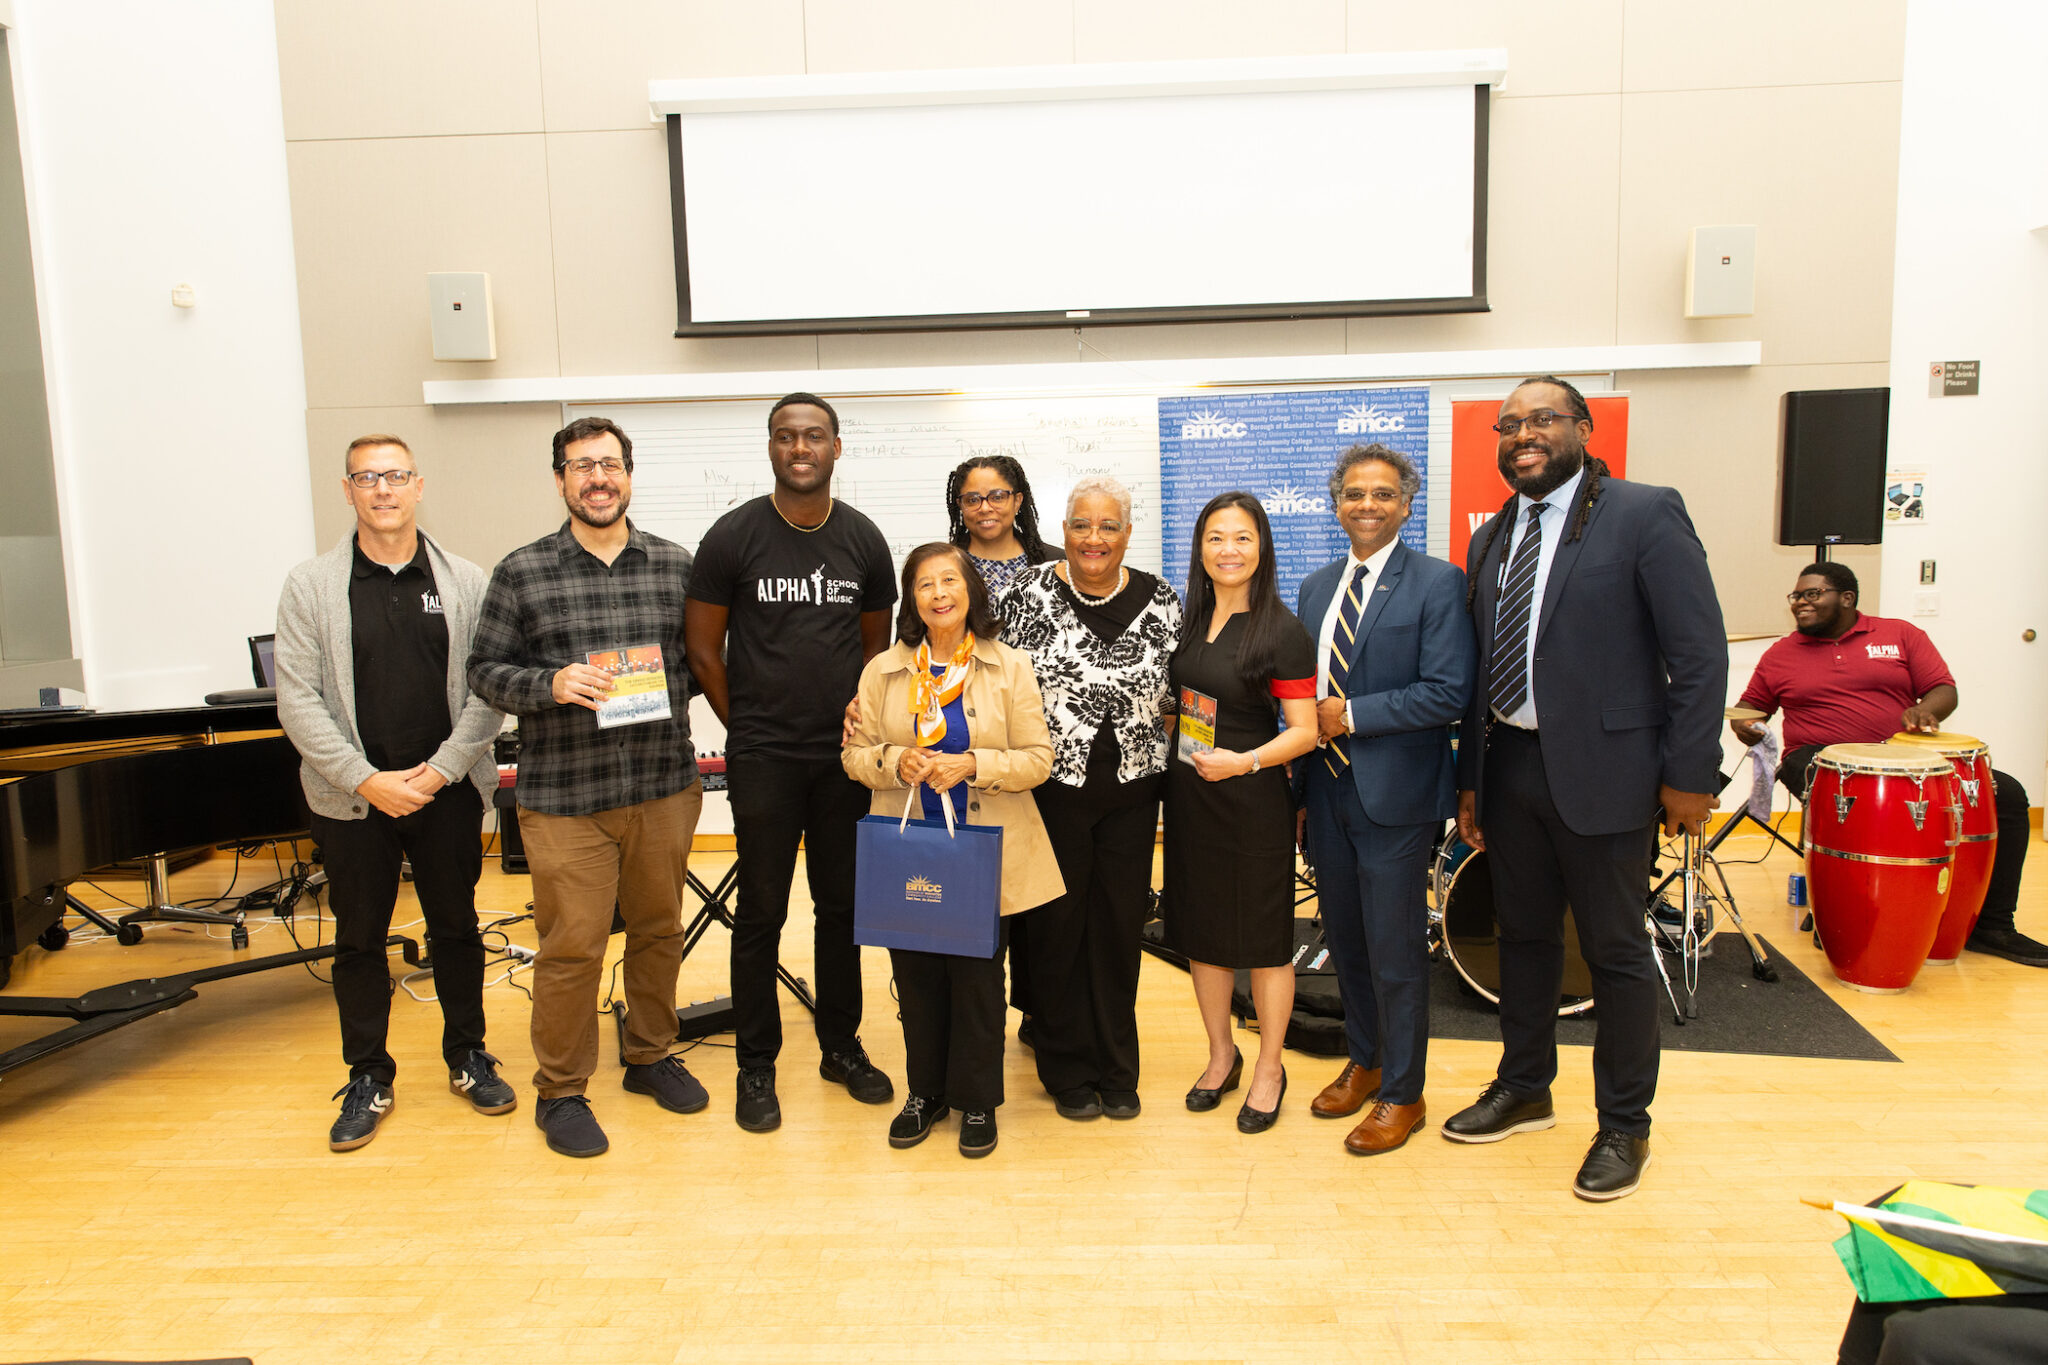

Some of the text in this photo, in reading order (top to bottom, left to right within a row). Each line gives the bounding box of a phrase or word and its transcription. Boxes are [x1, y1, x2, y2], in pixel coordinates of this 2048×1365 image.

[1958, 362, 1975, 370] Food
[826, 580, 860, 590] SCHOOL
[758, 578, 811, 602] ALPHA
[826, 588, 840, 596] OF
[826, 595, 854, 604] MUSIC
[1872, 644, 1900, 655] ALPHA
